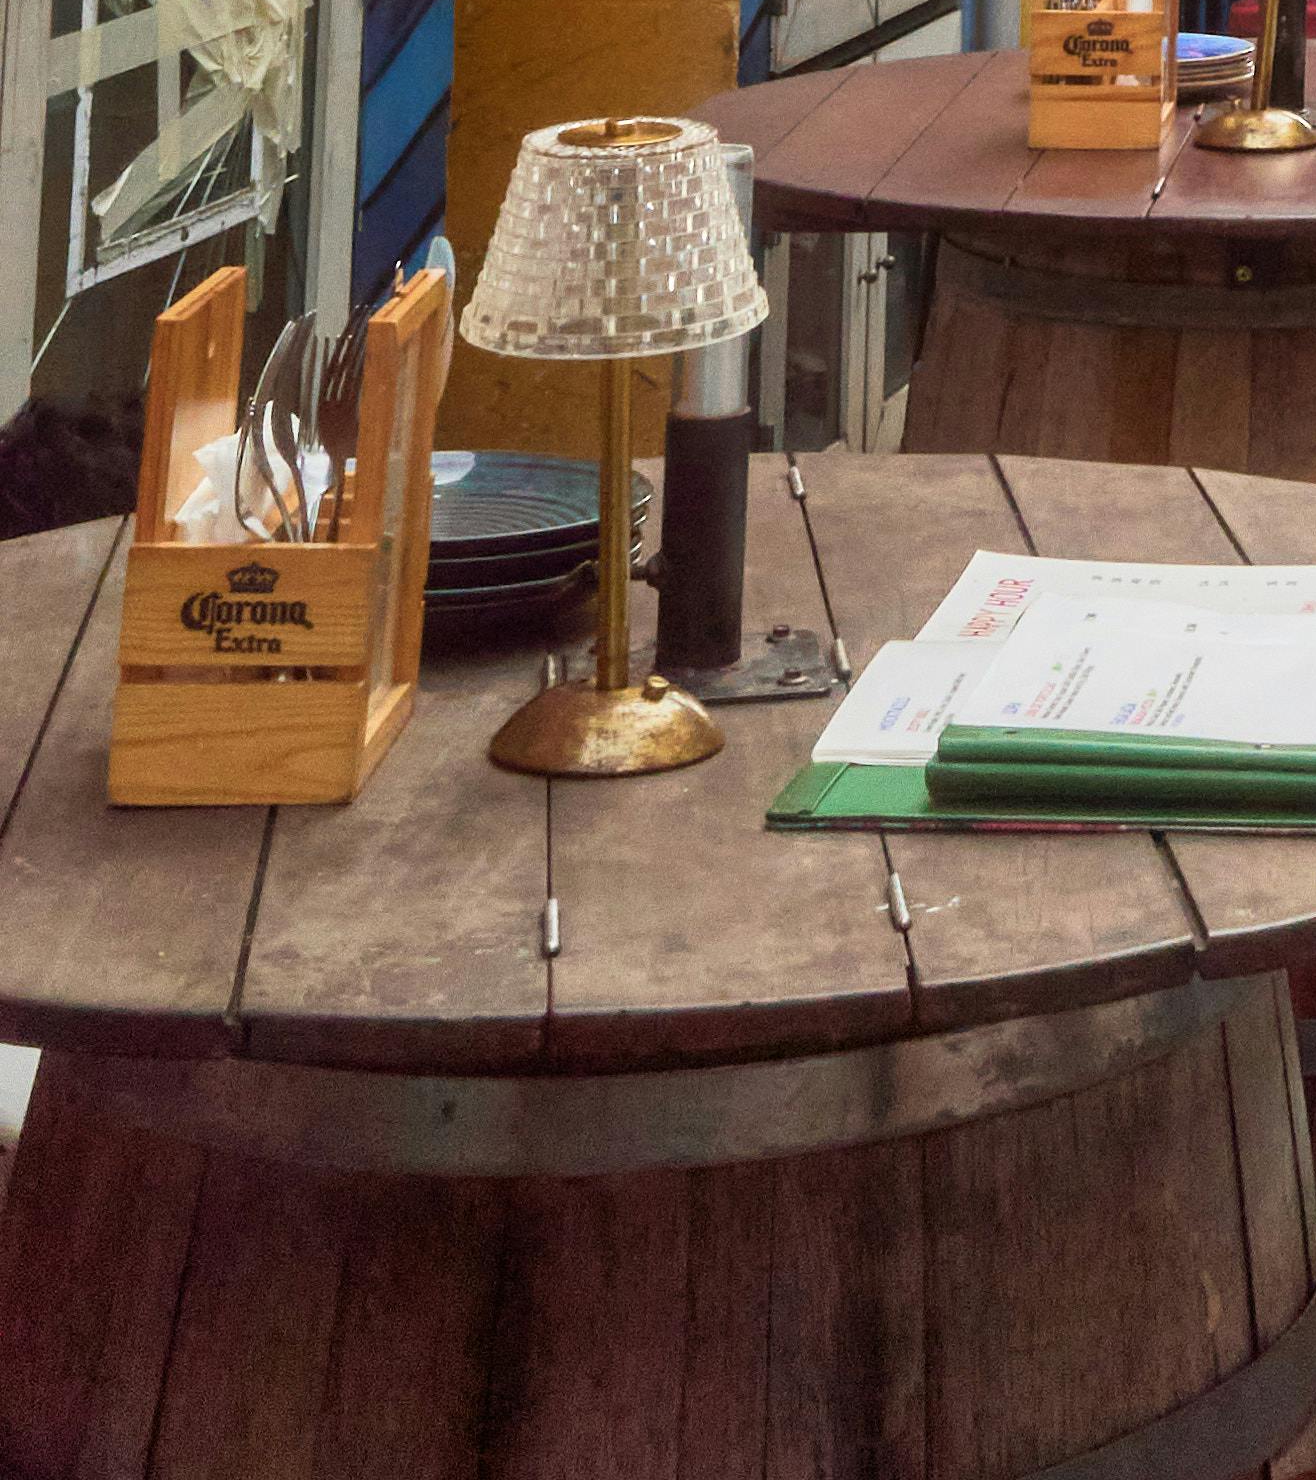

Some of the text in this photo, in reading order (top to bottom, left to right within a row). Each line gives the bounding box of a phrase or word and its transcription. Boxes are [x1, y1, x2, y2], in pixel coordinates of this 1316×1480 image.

[1063, 34, 1134, 58] Corona
[983, 578, 1035, 608] HOUR
[181, 590, 314, 635] Corona
[214, 627, 282, 654] Extra
